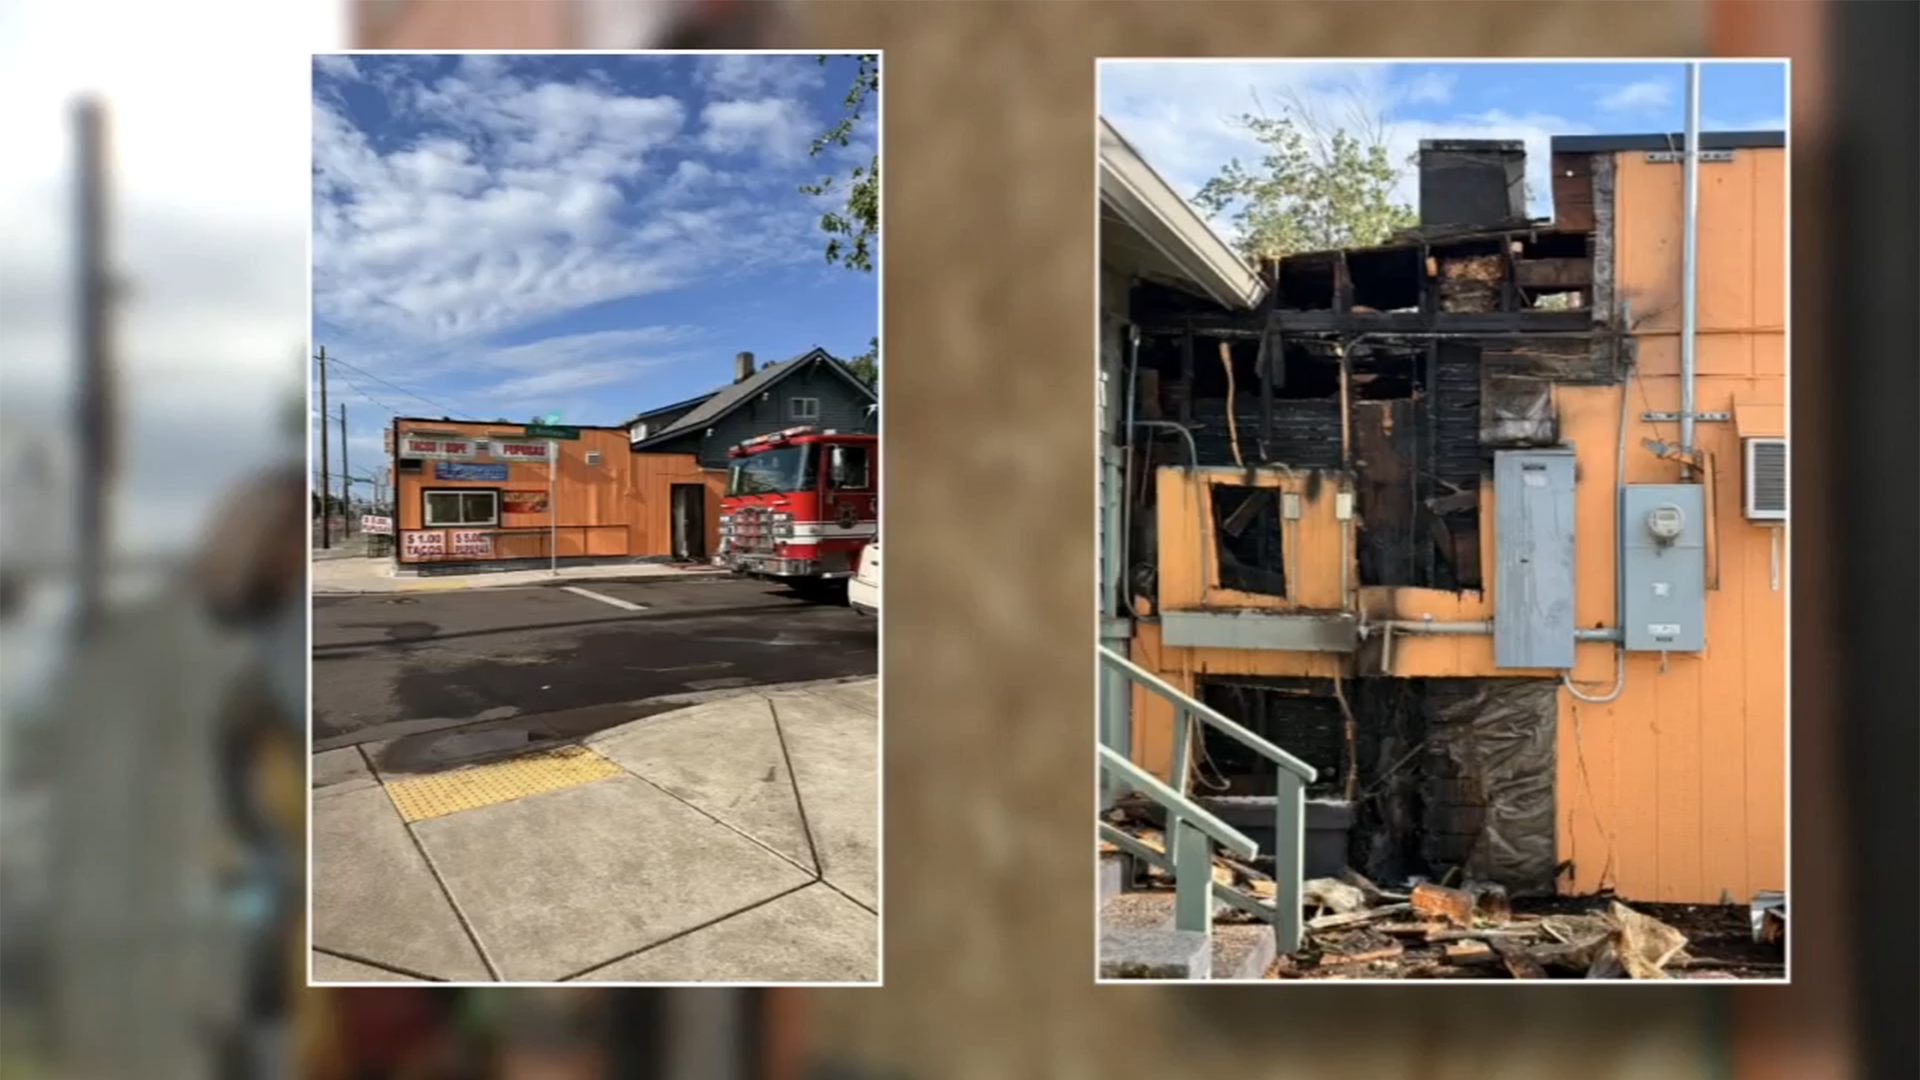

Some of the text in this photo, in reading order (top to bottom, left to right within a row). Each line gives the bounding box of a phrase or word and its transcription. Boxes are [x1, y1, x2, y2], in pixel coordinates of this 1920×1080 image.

[409, 440, 436, 452] TACOS
[407, 534, 441, 544] $ 1.00
[455, 533, 461, 543] $
[406, 545, 443, 556] TACOS
